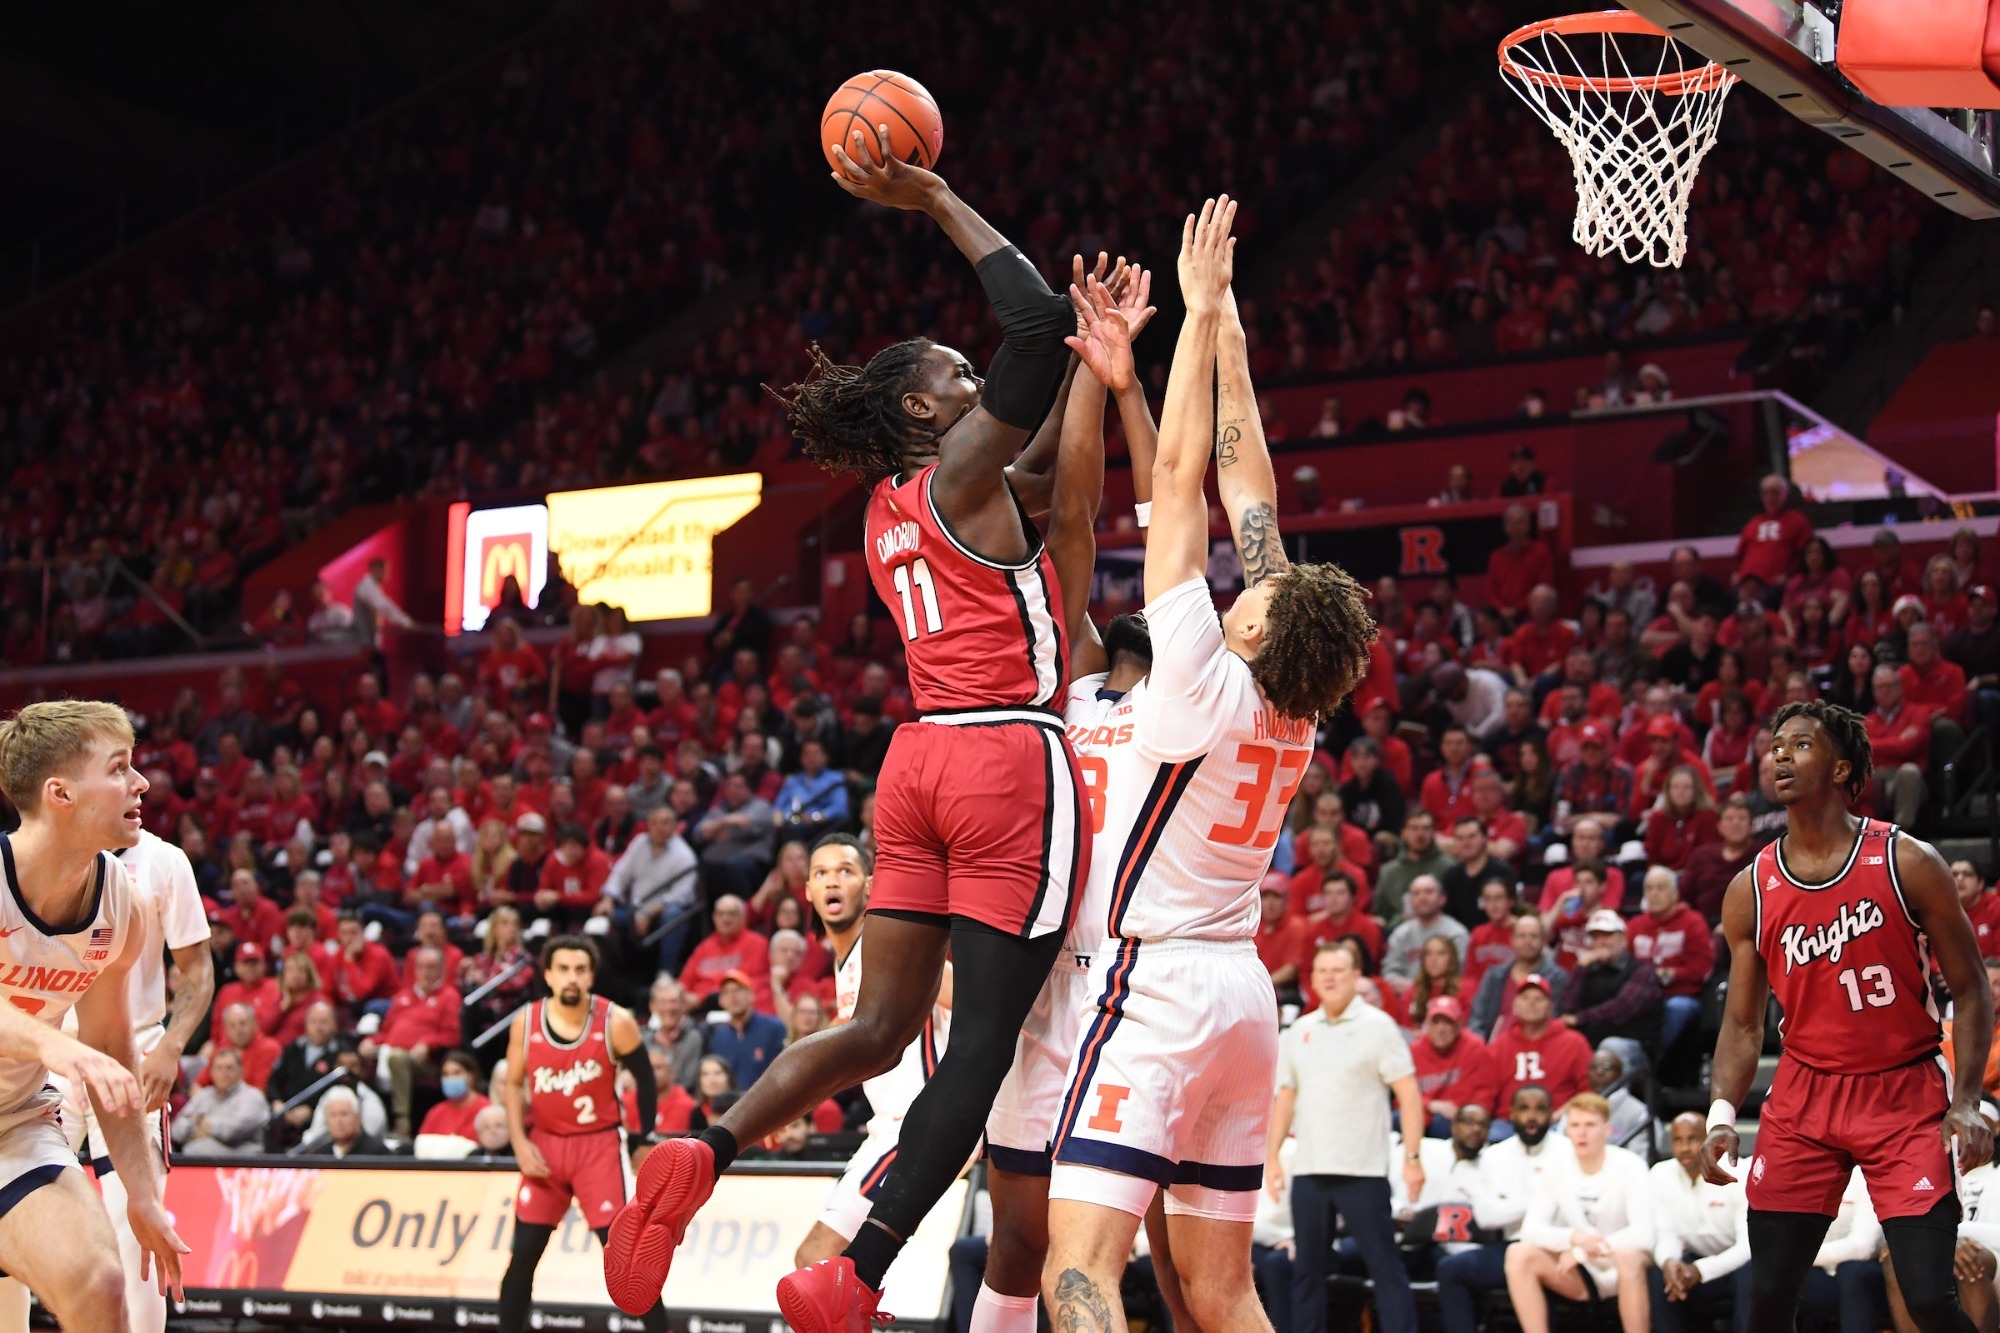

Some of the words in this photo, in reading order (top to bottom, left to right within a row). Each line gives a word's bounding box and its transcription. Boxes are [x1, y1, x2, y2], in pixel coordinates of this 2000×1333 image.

[1400, 527, 1447, 574] R
[893, 556, 943, 641] 11
[1207, 743, 1310, 848] 33
[1780, 898, 1884, 975] Knights
[1839, 964, 1896, 1012] 13
[533, 1059, 603, 1096] Knights
[1515, 1051, 1545, 1081] R
[573, 1095, 597, 1124] 2
[1088, 1083, 1130, 1133] I
[352, 1198, 479, 1266] Only
[491, 1198, 515, 1250] i
[1432, 1206, 1473, 1241] R
